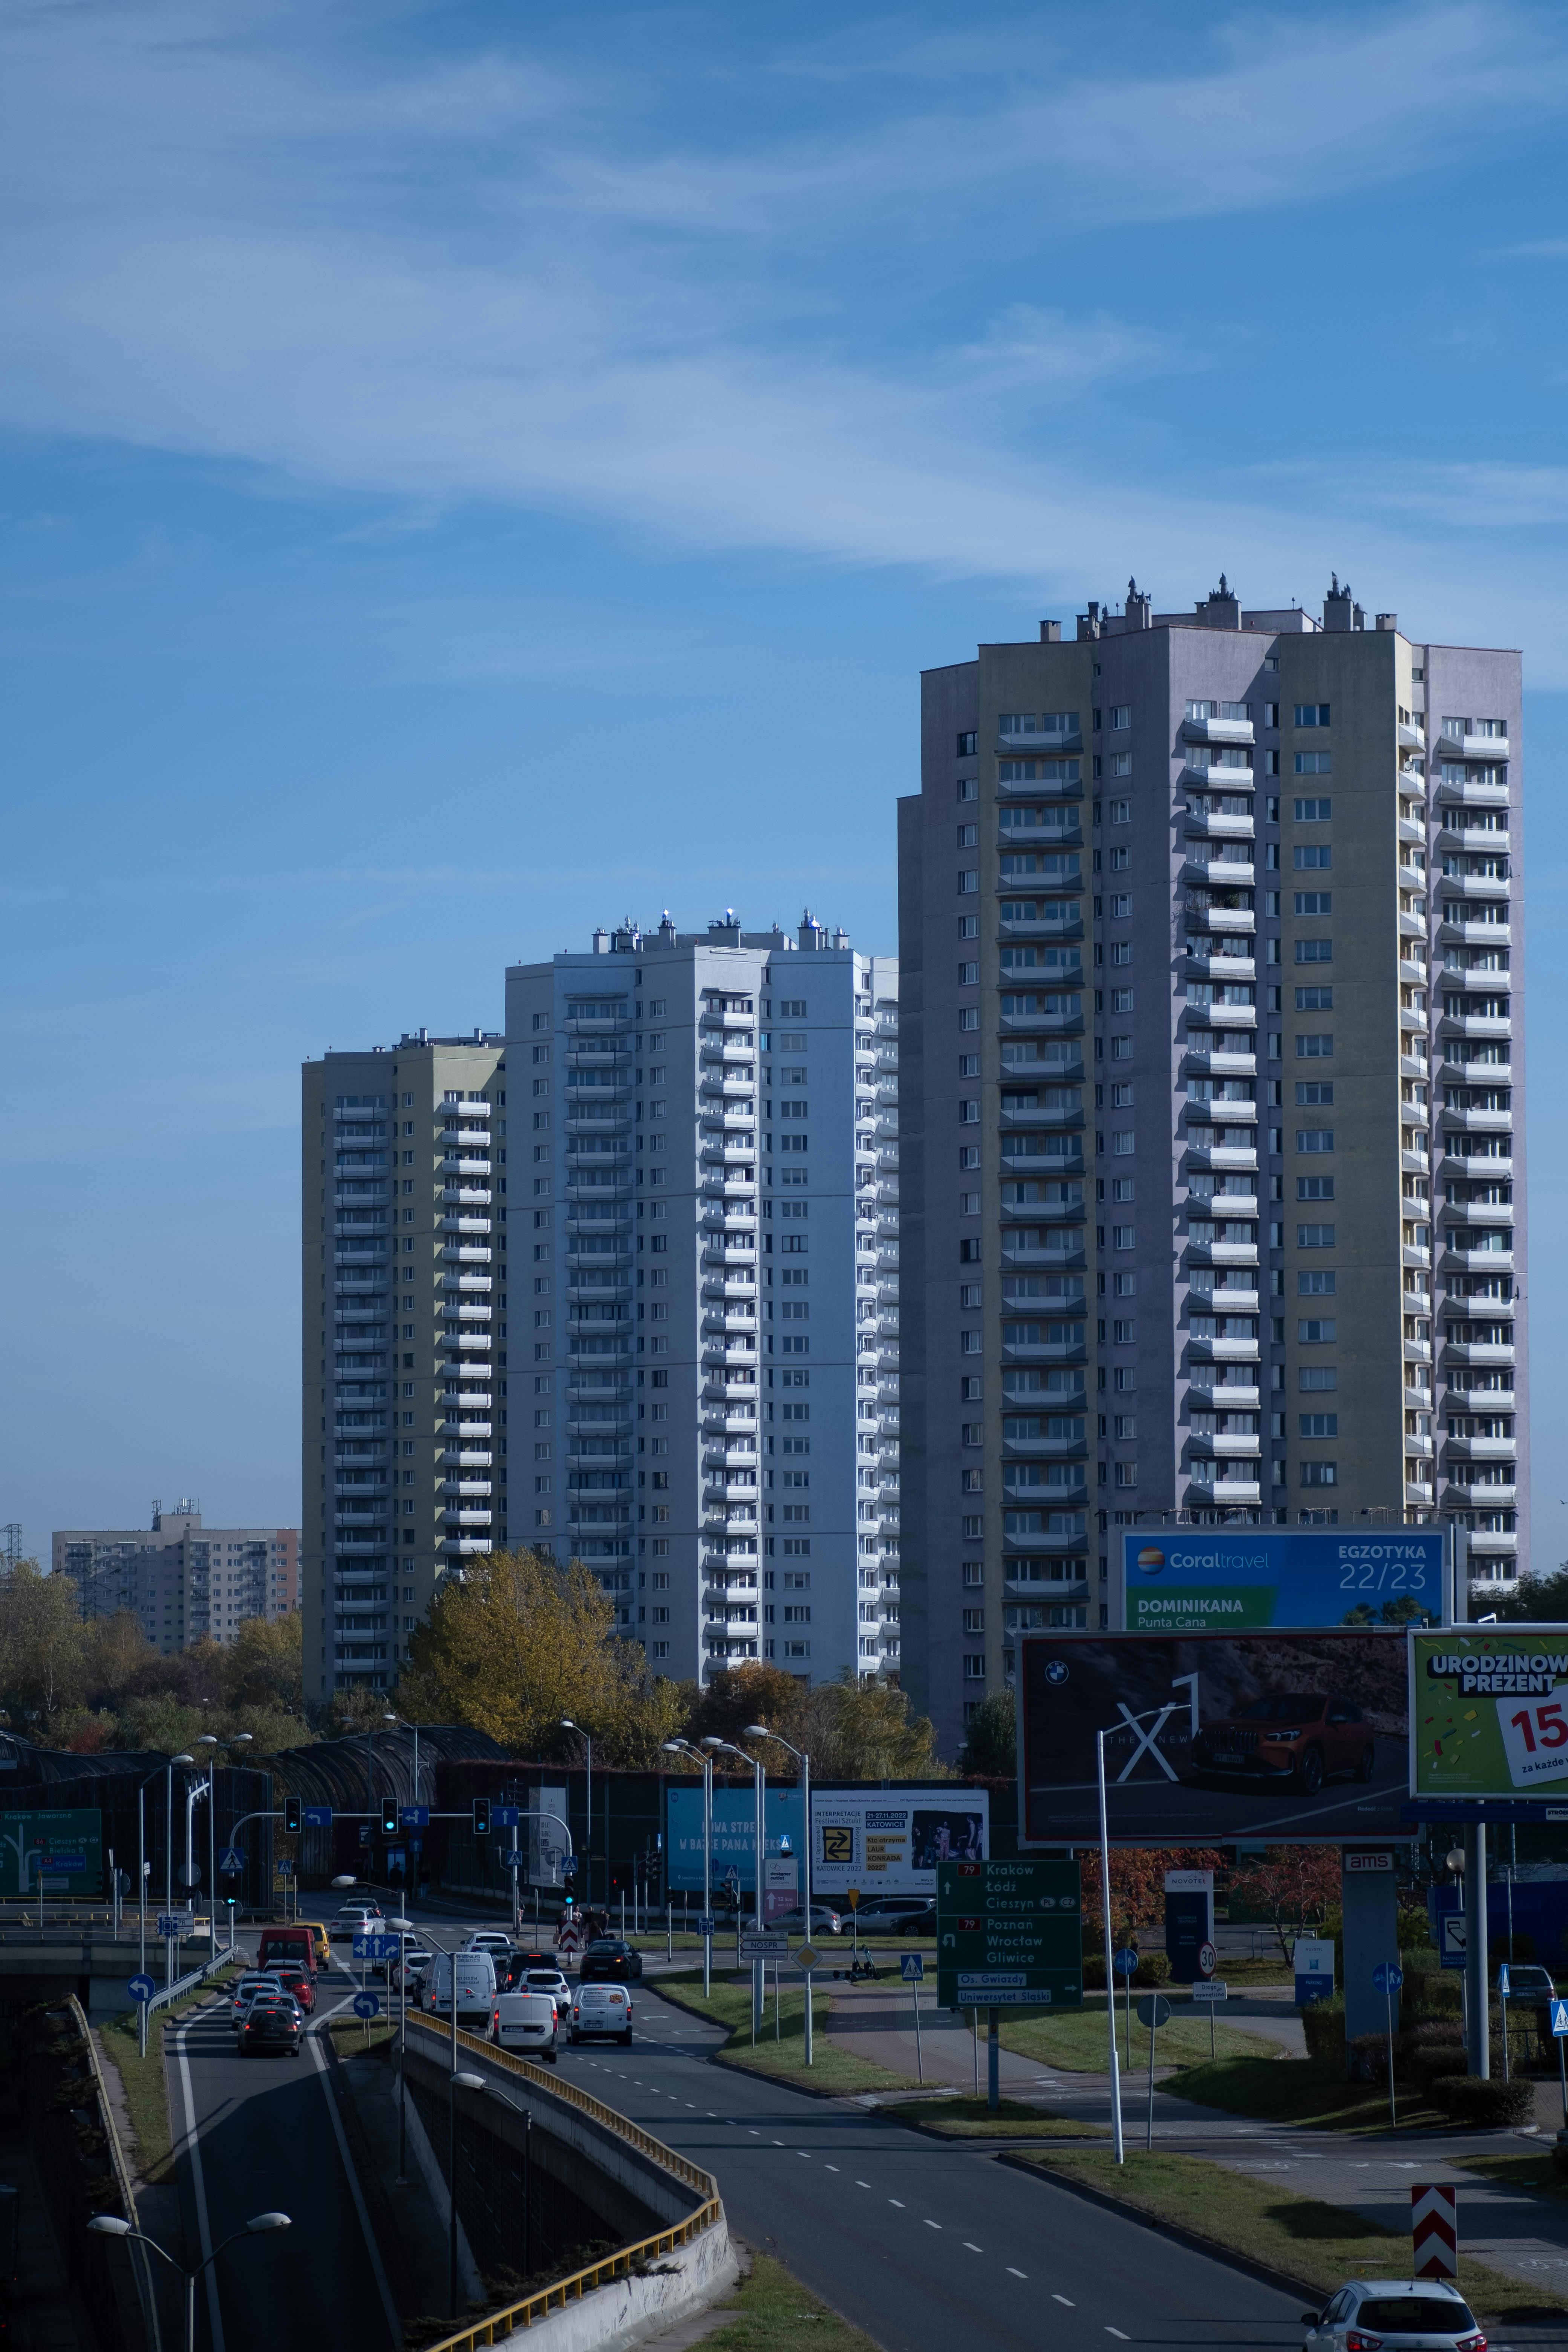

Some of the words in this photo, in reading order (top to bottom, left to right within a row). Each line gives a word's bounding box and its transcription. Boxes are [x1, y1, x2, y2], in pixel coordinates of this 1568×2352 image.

[1339, 1545, 1426, 1559] EGZOTYKA
[1340, 1563, 1426, 1590] 22/23
[1138, 1600, 1243, 1612] DOMINIKANA
[1138, 1617, 1173, 1627] Punta
[1176, 1617, 1206, 1627] Cana
[1433, 1655, 1568, 1674] URODZINOW
[1463, 1674, 1556, 1692] PREZENT
[1159, 1735, 1188, 1744] NEW
[1534, 1758, 1564, 1770] każde
[731, 1821, 767, 1833] STRE
[680, 1839, 687, 1850] W
[722, 1839, 748, 1850] PANA
[1351, 1855, 1388, 1868] ams
[964, 1865, 975, 1875] 79
[987, 1864, 1034, 1875] Kraków
[985, 1881, 1017, 1892] Łódź
[986, 1897, 1034, 1911] Cieszyn
[964, 1920, 975, 1929] 79
[988, 1918, 1033, 1929] Poznań
[986, 1935, 1043, 1946] Wrocław
[987, 1952, 1034, 1963] Gliwice
[1202, 1951, 1213, 1967] 30
[961, 1975, 977, 1984] Os.
[982, 1974, 1023, 1984] Gwiazdy
[960, 1992, 1017, 2003] Uniwersytet
